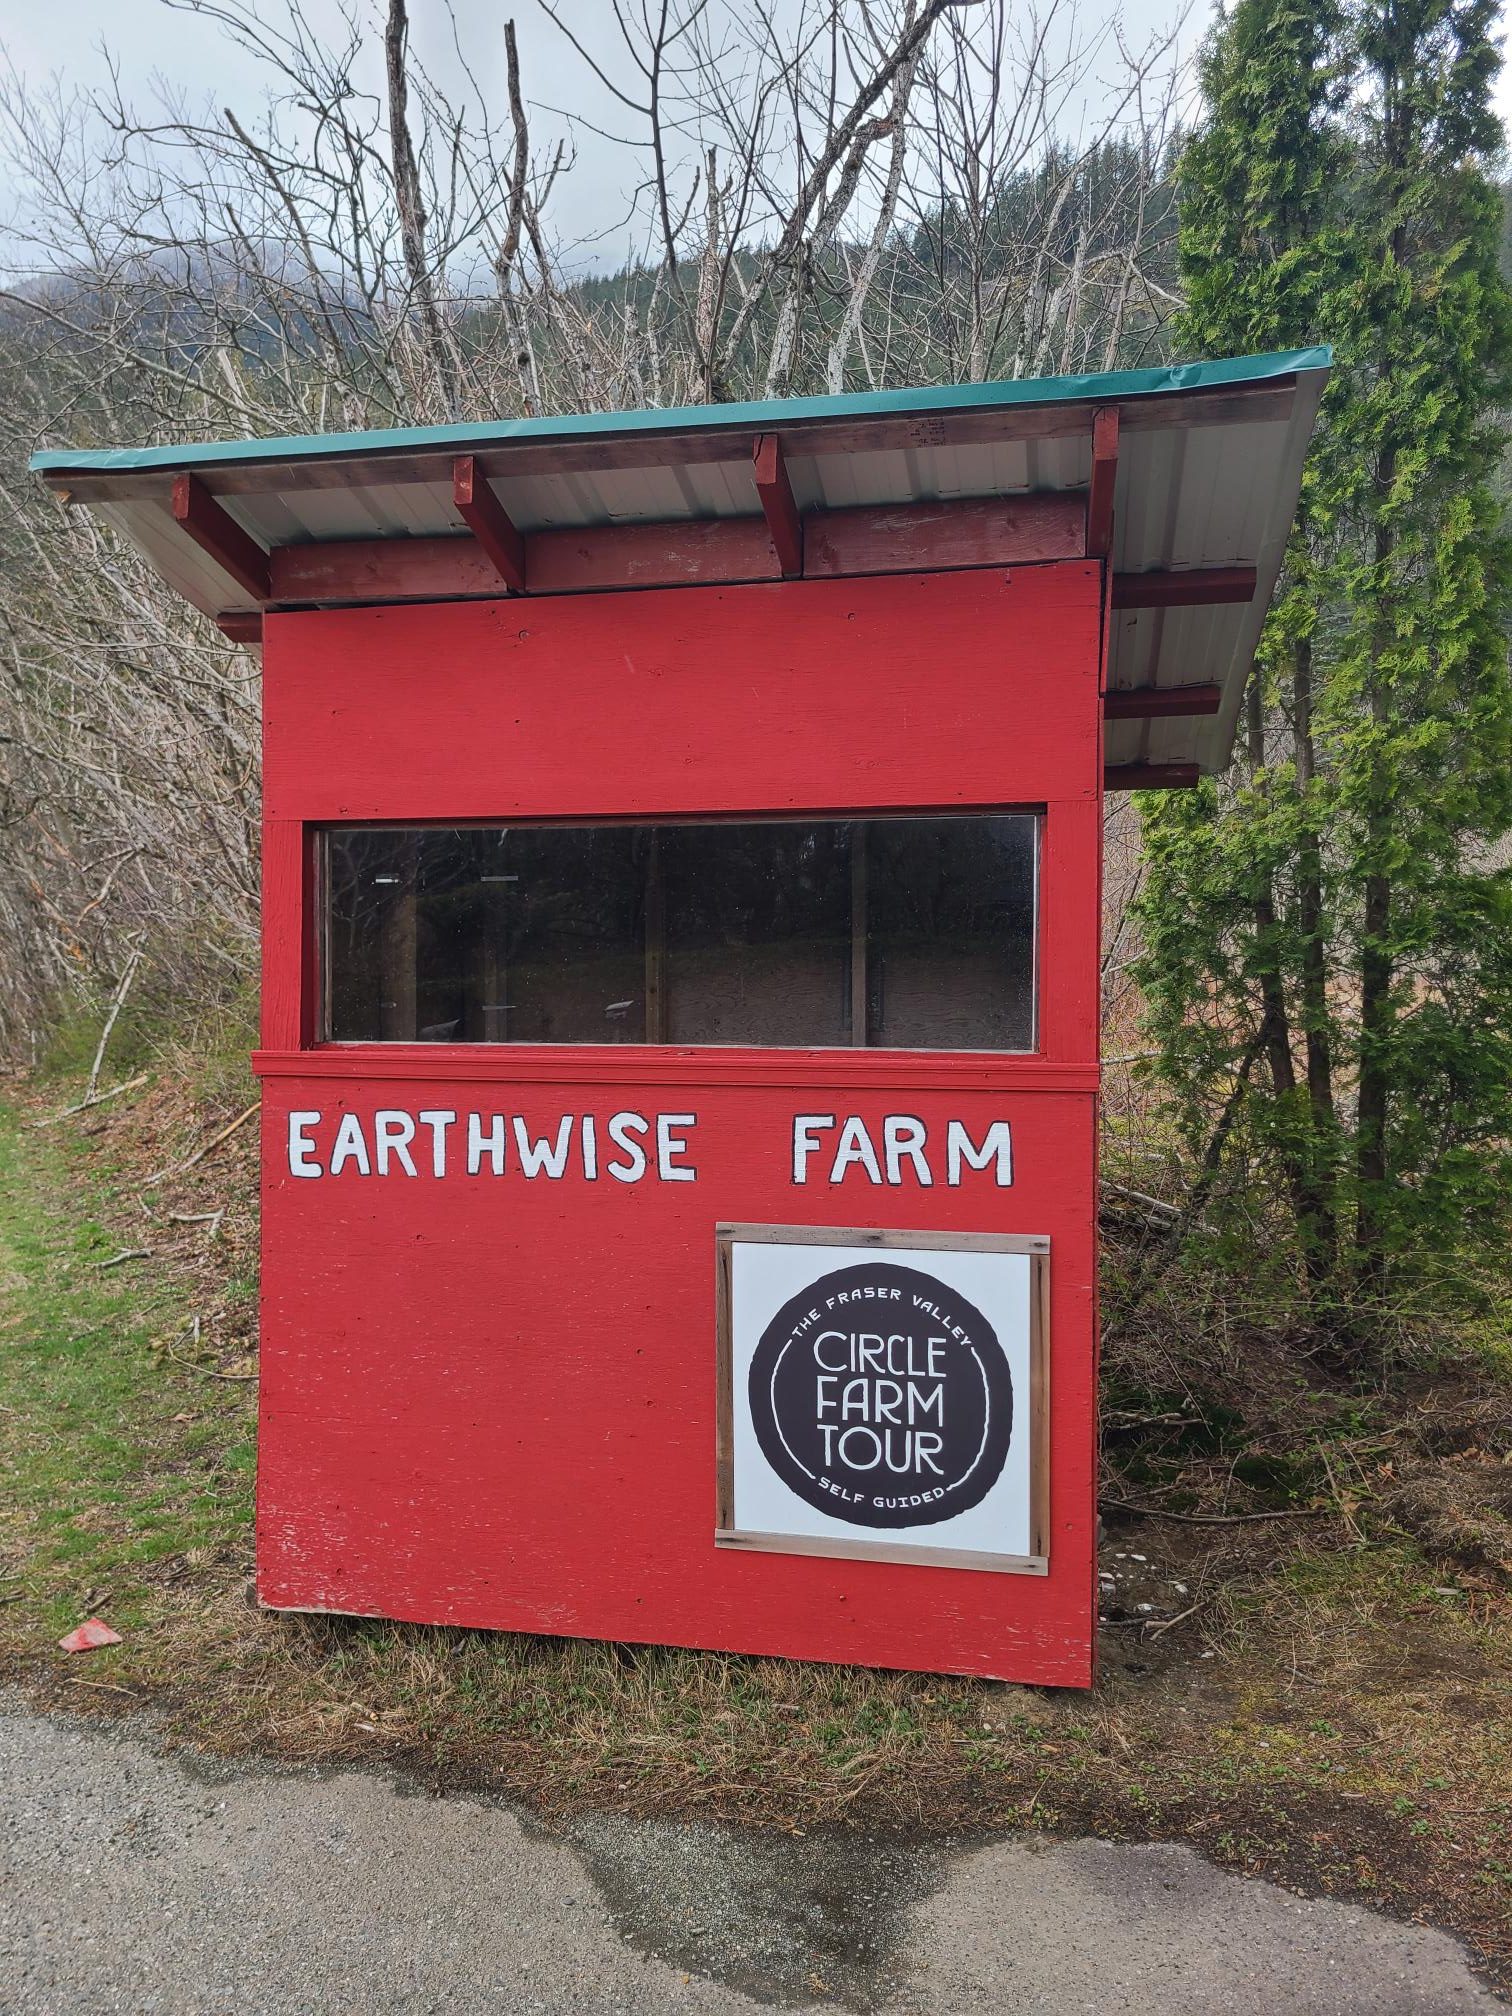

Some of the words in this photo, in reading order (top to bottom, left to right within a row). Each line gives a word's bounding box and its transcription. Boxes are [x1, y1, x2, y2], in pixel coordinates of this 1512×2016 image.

[288, 1110, 696, 1183] EARTHWISE
[793, 1115, 1013, 1186] FARM
[791, 1308, 822, 1338] THE
[825, 1286, 902, 1310] FRASER
[912, 1294, 973, 1347] VALLEY
[813, 1330, 947, 1378] CIRCLE
[816, 1375, 944, 1428] FARM
[816, 1424, 945, 1476] TOUR
[817, 1476, 865, 1504] SELF
[872, 1487, 945, 1509] GUIDED
